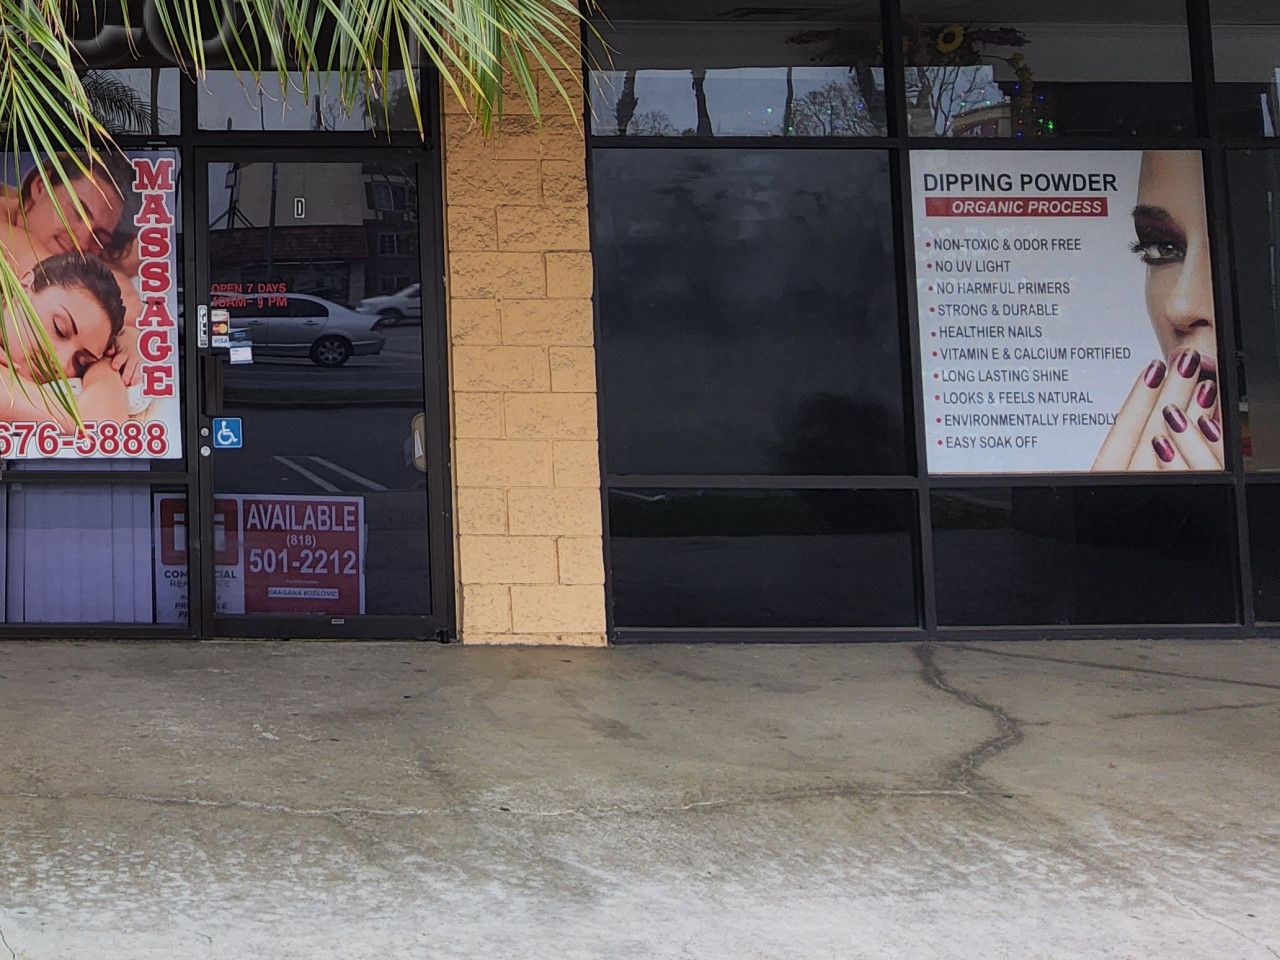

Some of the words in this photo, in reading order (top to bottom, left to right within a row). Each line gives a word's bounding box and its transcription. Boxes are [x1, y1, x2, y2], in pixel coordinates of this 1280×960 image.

[923, 173, 1013, 192] DIPPING
[1020, 173, 1118, 192] POWDER
[295, 198, 305, 218] D
[951, 200, 1024, 214] ORGANIC
[1028, 200, 1102, 214] PROCESS
[933, 238, 999, 251] NON-TOXIC
[1002, 238, 1011, 251] &
[1013, 238, 1048, 251] ODOR
[1051, 238, 1082, 251] FREE
[935, 260, 953, 272] NO
[956, 260, 972, 272] UV
[975, 260, 1011, 272] LIGHT
[132, 158, 175, 398] MASSAGE
[211, 283, 243, 293] OPEN
[246, 283, 254, 293] 7
[257, 283, 287, 293] DAYS
[936, 282, 954, 294] NO
[957, 282, 1014, 294] HARMFUL
[1018, 282, 1071, 294] PRIMERS
[268, 296, 288, 307] PM
[937, 304, 988, 316] STRONG
[991, 304, 1000, 316] &
[1002, 304, 1059, 316] DURABLE
[939, 325, 1005, 338] HEALTHIER
[1008, 325, 1043, 338] NAILS
[940, 347, 989, 360] VITAMIN
[991, 347, 1000, 360] E
[1002, 347, 1011, 360] &
[1014, 347, 1067, 360] CALCIUM
[1070, 347, 1131, 360] FORTIFIED
[941, 369, 975, 382] LONG
[978, 369, 1029, 382] LASTING
[1032, 369, 1069, 382] SHINE
[943, 391, 984, 404] LOOKS
[987, 391, 996, 404] &
[999, 391, 1035, 404] FEELS
[1038, 391, 1093, 404] NATURAL
[944, 413, 1059, 426] ENVIRONMENTALLY
[1062, 413, 1119, 426] FRIENDLY
[946, 436, 976, 449] EASY
[979, 436, 1013, 449] SOAK
[1016, 436, 1038, 449] OFF
[246, 503, 357, 532] AVAILABLE
[286, 533, 317, 549] (818)
[249, 548, 357, 575] 501-2212
